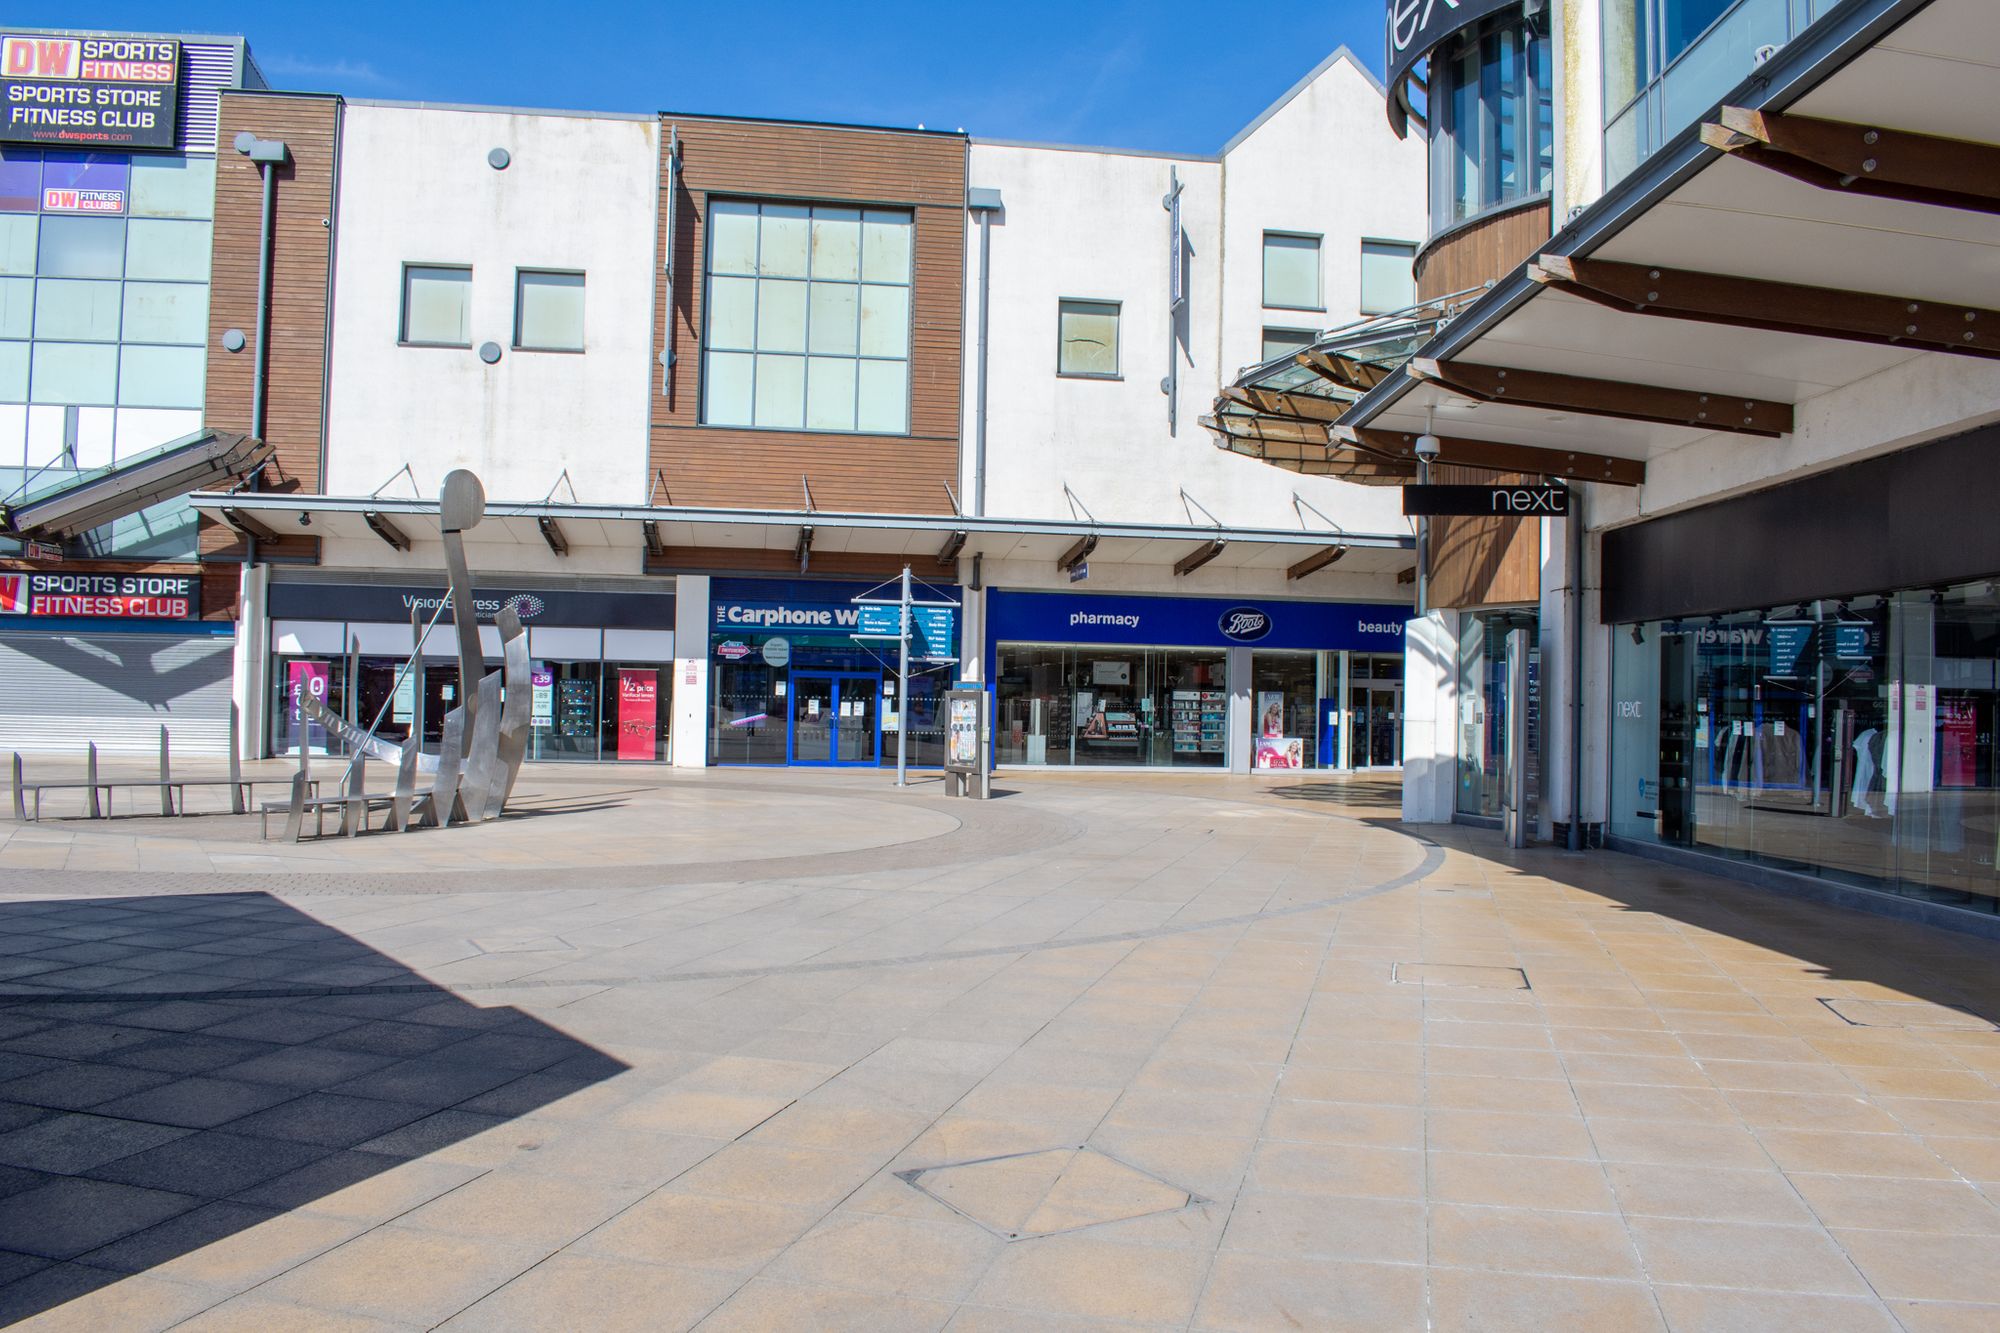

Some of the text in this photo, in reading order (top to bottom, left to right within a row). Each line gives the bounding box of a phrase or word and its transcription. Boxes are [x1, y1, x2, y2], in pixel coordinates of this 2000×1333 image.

[8, 39, 73, 76] DW
[83, 40, 173, 61] SPORTS
[81, 61, 172, 81] FITNESS
[8, 86, 161, 107] SPORTS STORE
[11, 107, 155, 129] FITNESS CLUB
[33, 131, 133, 141] www.dwsports.com
[47, 192, 77, 208] DW
[80, 191, 121, 201] FITNESS
[83, 201, 117, 210] CLUBS
[1493, 490, 1564, 511] next
[32, 576, 189, 595] SPORTS STORE
[31, 597, 187, 617] FITNESS CLUB
[716, 605, 726, 623] THE
[728, 606, 832, 627] Carphone
[1070, 612, 1139, 628] pharmacy
[1225, 614, 1265, 634] Boots
[1358, 620, 1402, 635] beauty
[1616, 701, 1641, 717] next
